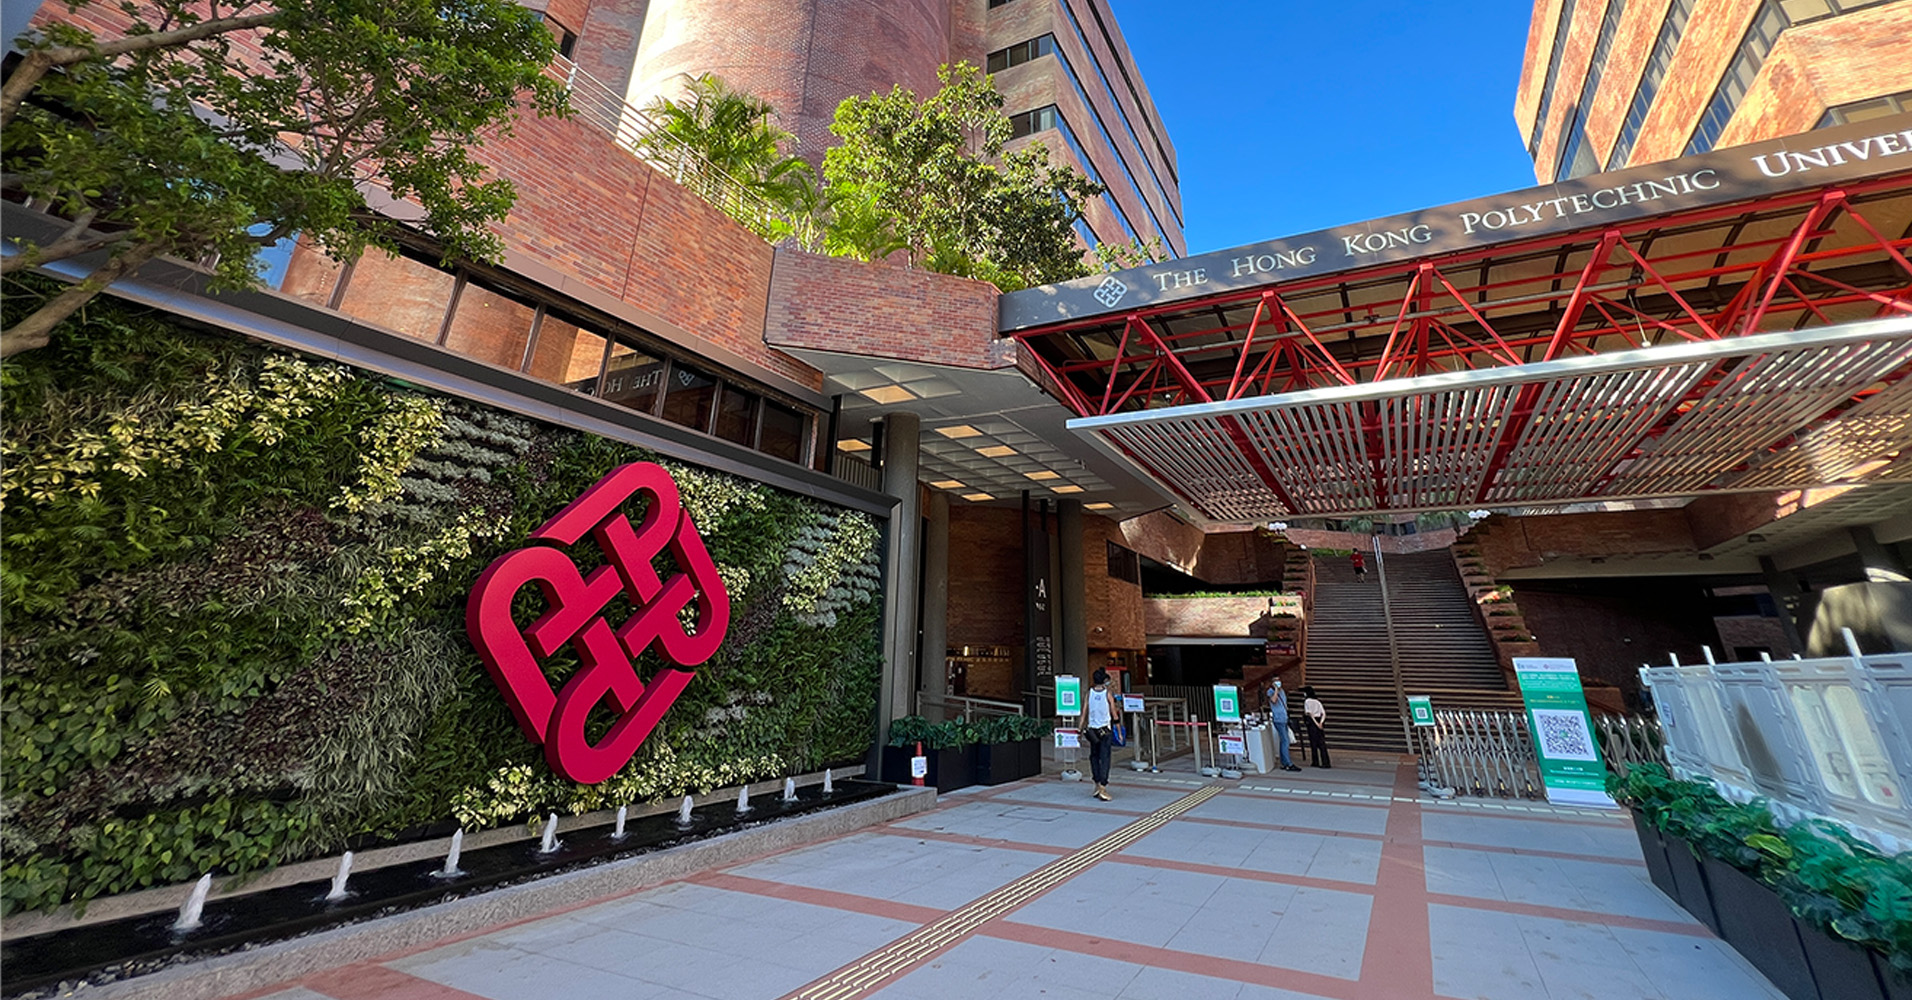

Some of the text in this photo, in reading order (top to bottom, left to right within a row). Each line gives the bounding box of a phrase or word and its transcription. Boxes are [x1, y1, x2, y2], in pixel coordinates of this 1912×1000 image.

[1153, 267, 1208, 292] THE
[1231, 246, 1317, 278] HONG
[1341, 224, 1433, 257] KONG
[1459, 168, 1720, 235] POLYTECHNIC
